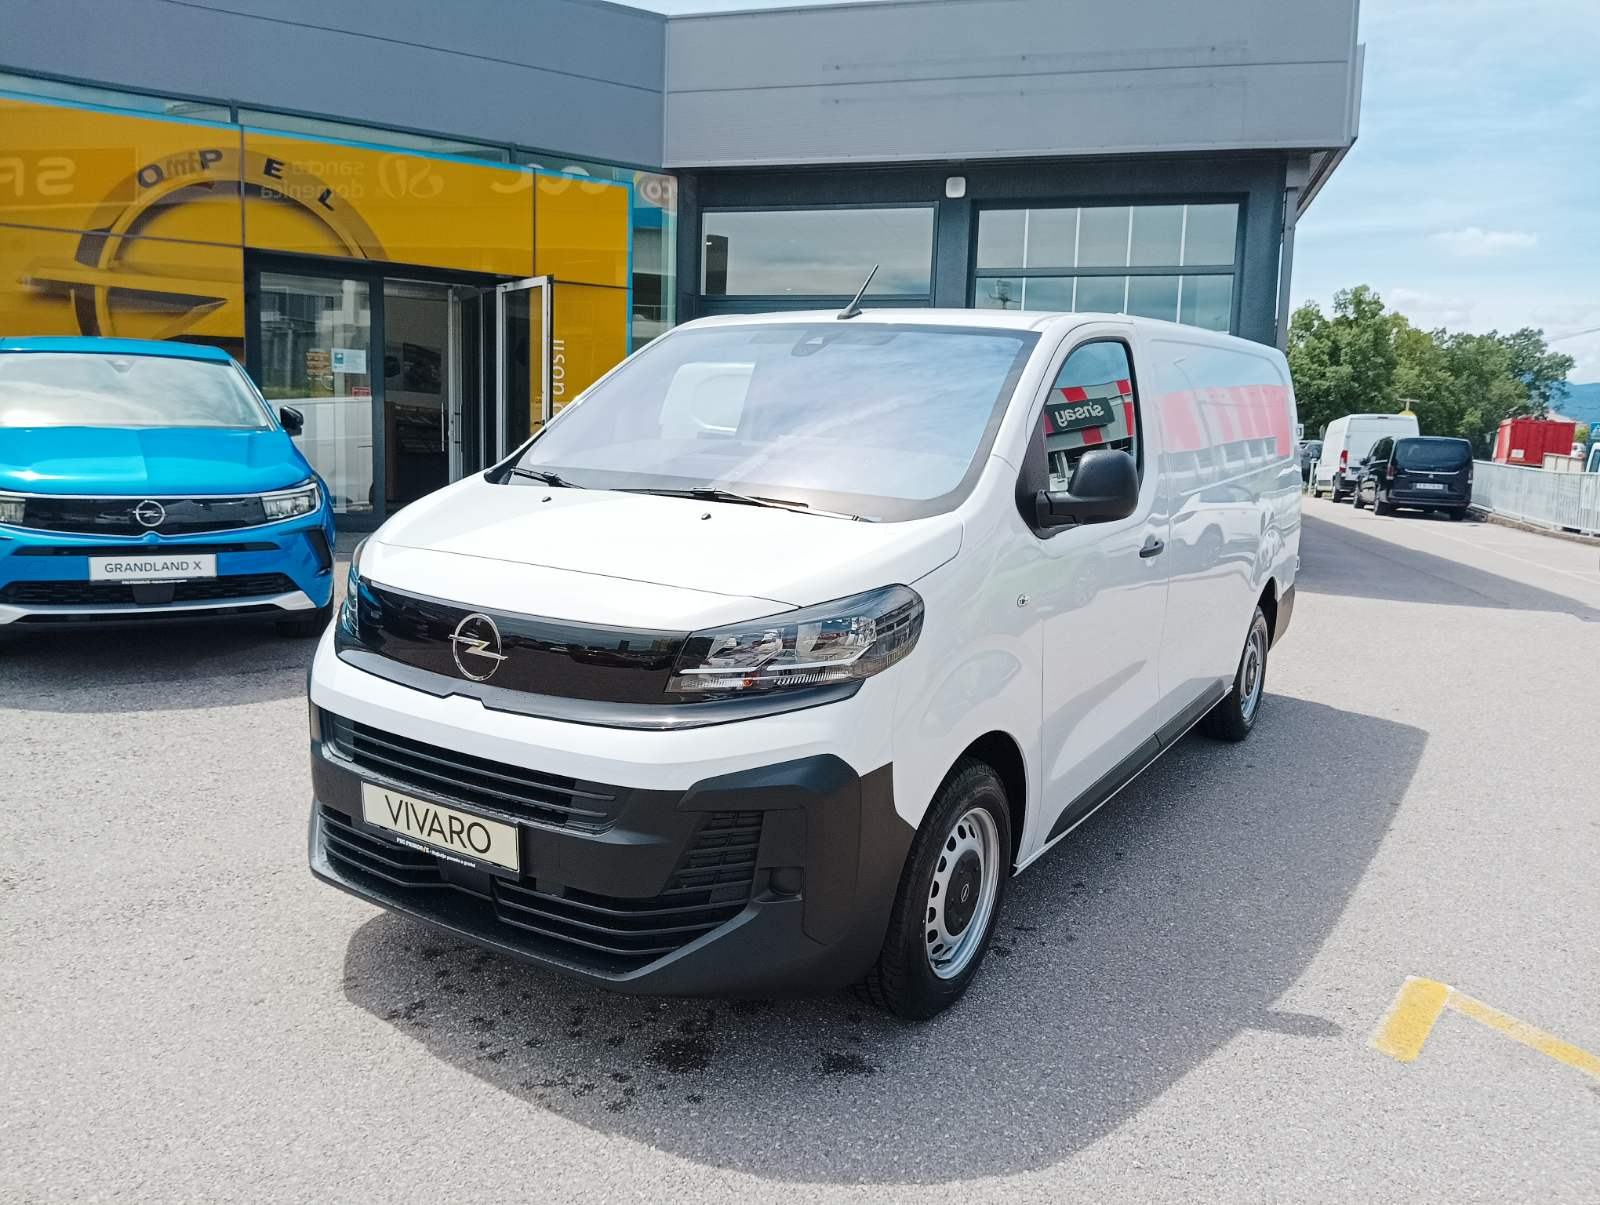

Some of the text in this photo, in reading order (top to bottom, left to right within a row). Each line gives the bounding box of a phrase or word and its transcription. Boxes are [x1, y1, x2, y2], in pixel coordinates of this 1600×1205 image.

[137, 149, 335, 212] OPEL
[104, 561, 202, 574] GRANDLAND X
[384, 794, 492, 854] VIVARO
